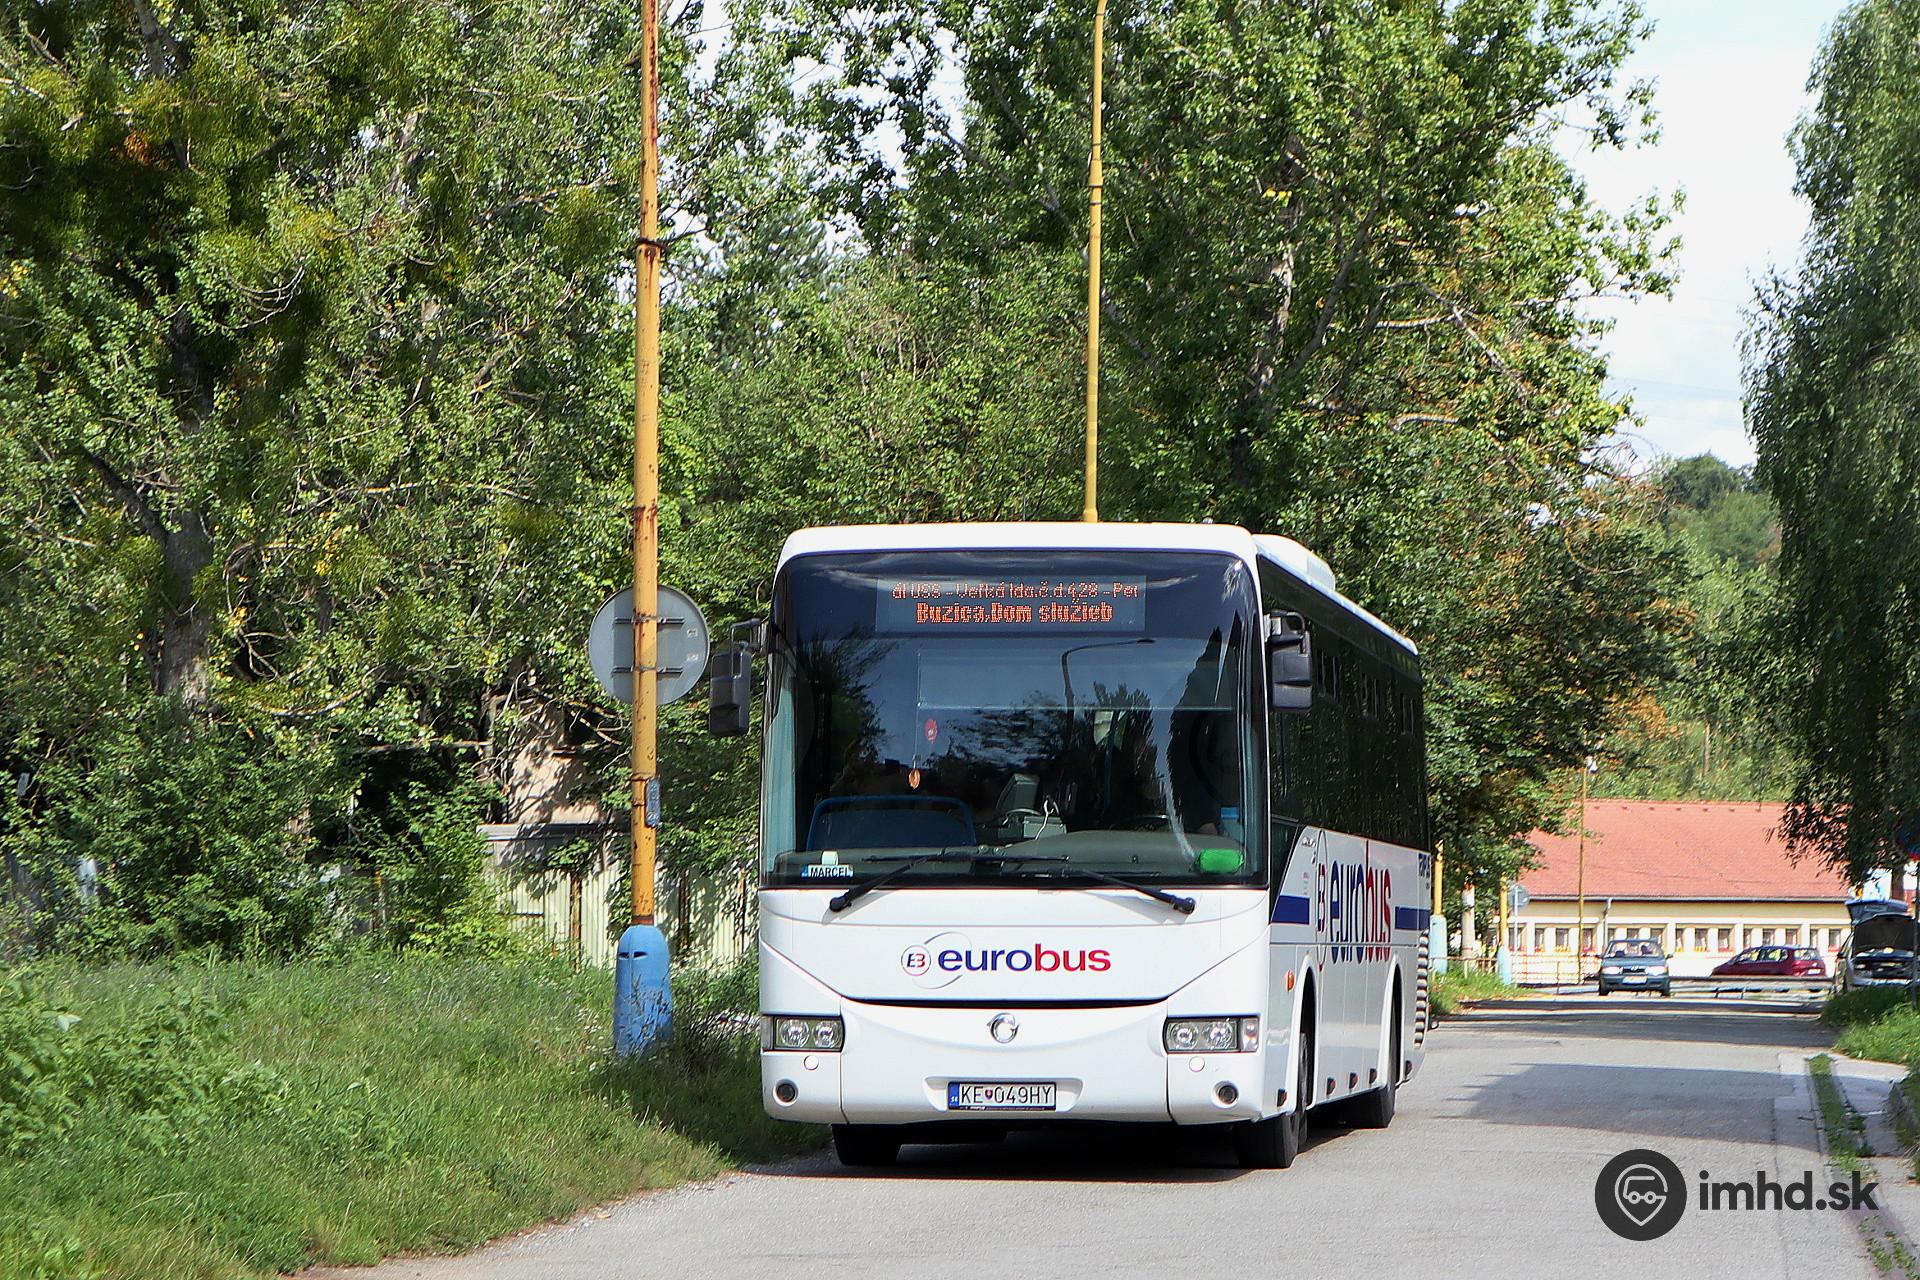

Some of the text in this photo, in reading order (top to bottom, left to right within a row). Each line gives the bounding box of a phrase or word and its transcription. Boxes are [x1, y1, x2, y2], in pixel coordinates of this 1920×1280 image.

[916, 598, 1113, 624] Buzica,Dom služieb
[810, 867, 852, 878] MARCEL
[1330, 840, 1391, 964] eurobus
[937, 943, 1111, 972] eurobus
[961, 1086, 1051, 1104] KE 049HY
